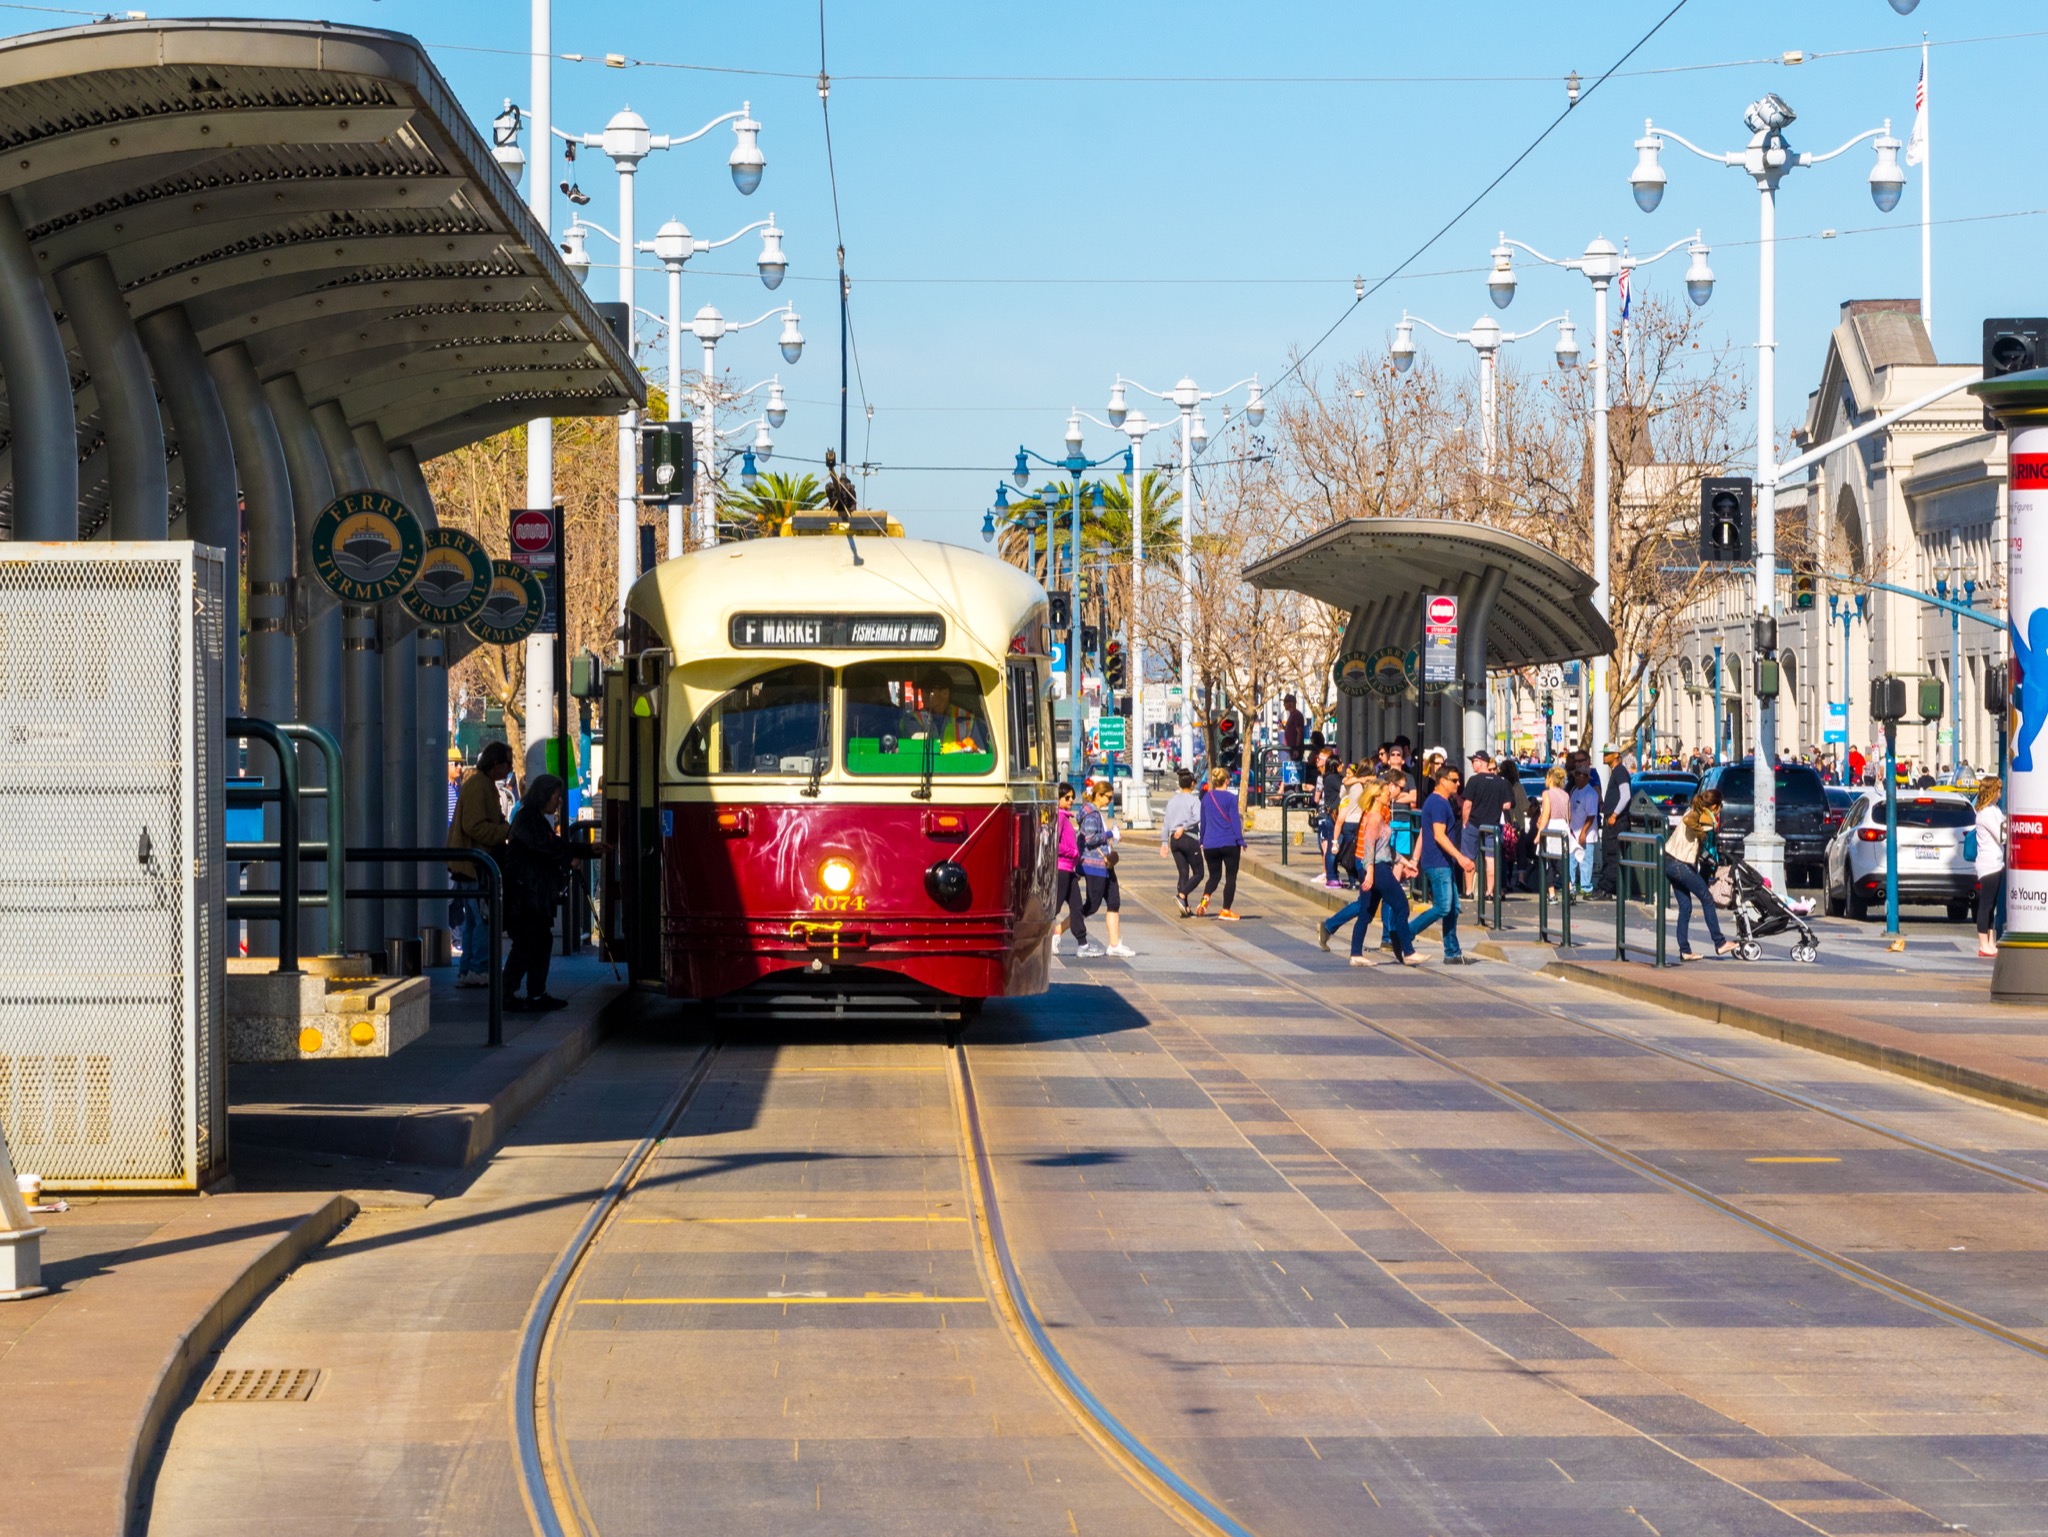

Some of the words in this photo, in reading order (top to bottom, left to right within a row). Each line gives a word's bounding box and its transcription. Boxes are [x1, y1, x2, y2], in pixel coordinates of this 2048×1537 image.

[329, 495, 409, 522] FERRY
[424, 531, 479, 556] ERRY
[318, 554, 418, 600] TERMINAL
[498, 563, 532, 584] RRY
[406, 583, 488, 621] ERMINAL
[471, 607, 540, 641] ERMINAL
[746, 619, 756, 643] F
[762, 619, 823, 643] MARKET
[851, 623, 907, 642] FISHERMAN'S
[1540, 676, 1559, 688] 30
[2010, 822, 2043, 834] HARING
[813, 895, 866, 911] 1074
[2010, 886, 2018, 900] de
[2018, 887, 2047, 904] Young
